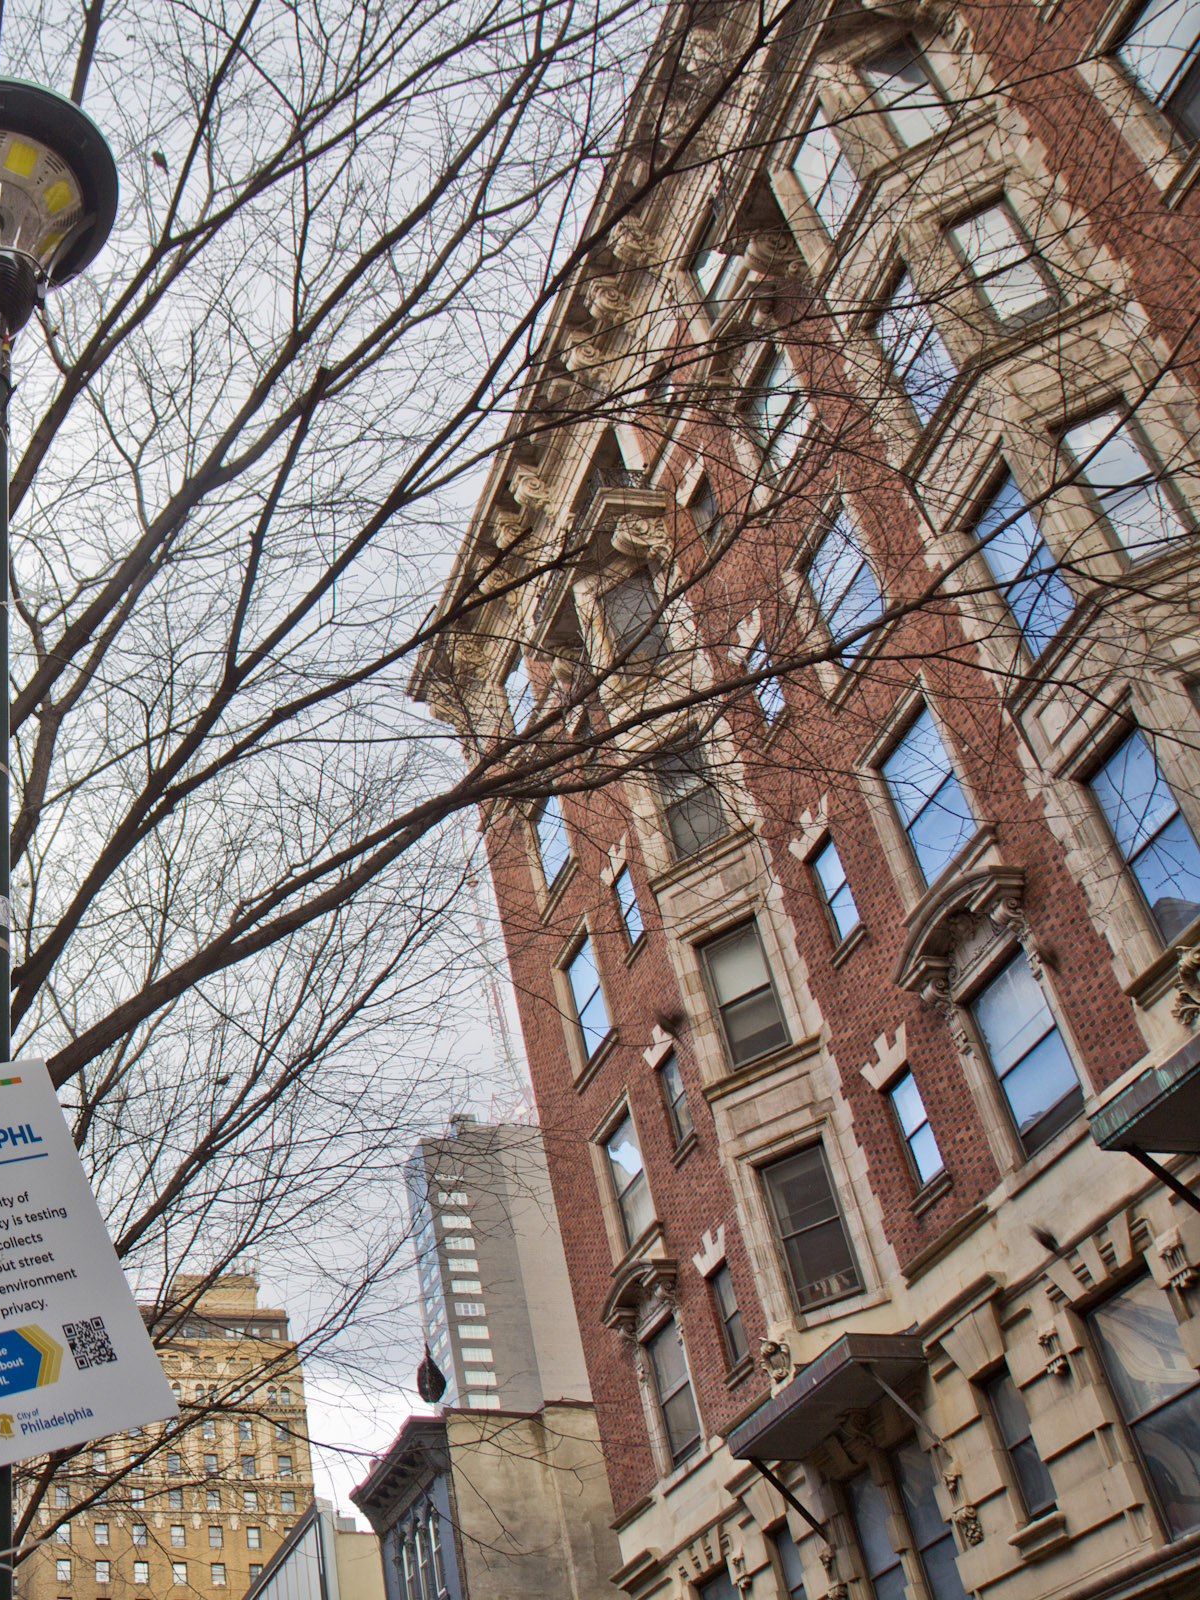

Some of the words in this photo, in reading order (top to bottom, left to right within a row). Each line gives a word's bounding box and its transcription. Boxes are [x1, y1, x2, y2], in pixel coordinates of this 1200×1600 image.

[17, 1191, 29, 1204] of
[12, 1215, 23, 1226] is
[24, 1208, 67, 1223] testing
[18, 1252, 54, 1268] street
[0, 1298, 48, 1320] privacy.
[16, 1411, 31, 1421] City
[32, 1408, 39, 1417] of
[20, 1406, 94, 1436] Philadelphia
